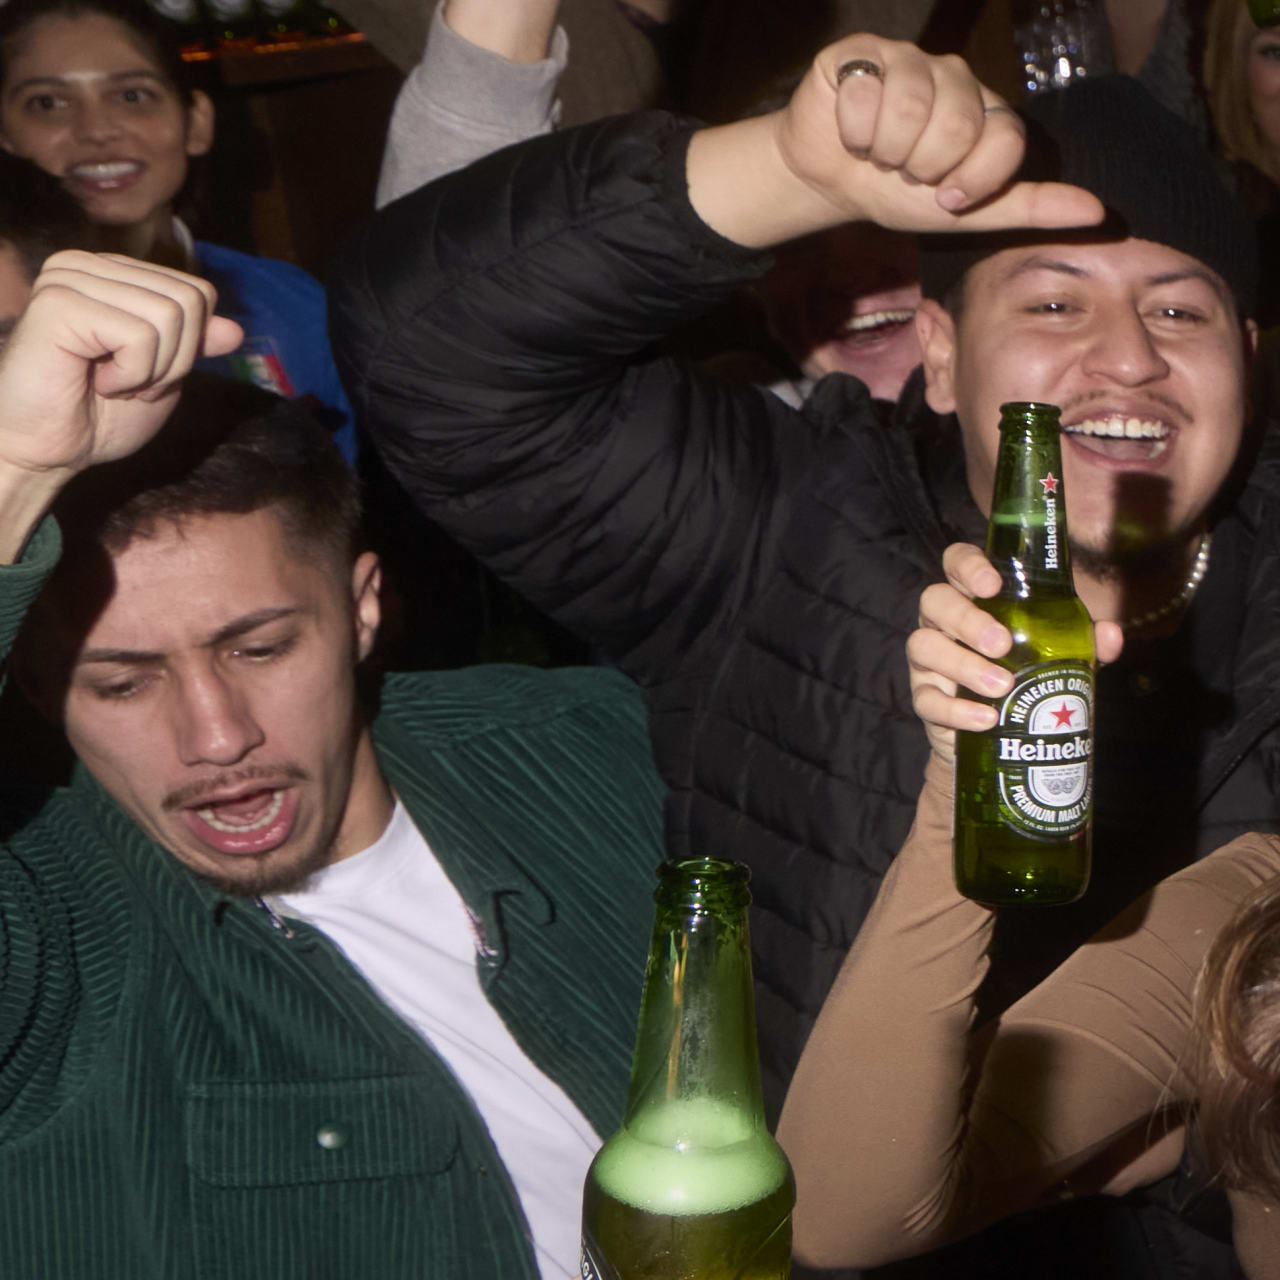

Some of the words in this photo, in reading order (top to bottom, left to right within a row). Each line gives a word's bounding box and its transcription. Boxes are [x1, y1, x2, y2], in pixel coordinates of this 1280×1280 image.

[1043, 497, 1058, 570] Heineken
[1010, 678, 1065, 724] HEINEKEN
[1010, 784, 1057, 823] PREMIUM
[1058, 804, 1081, 823] MALT
